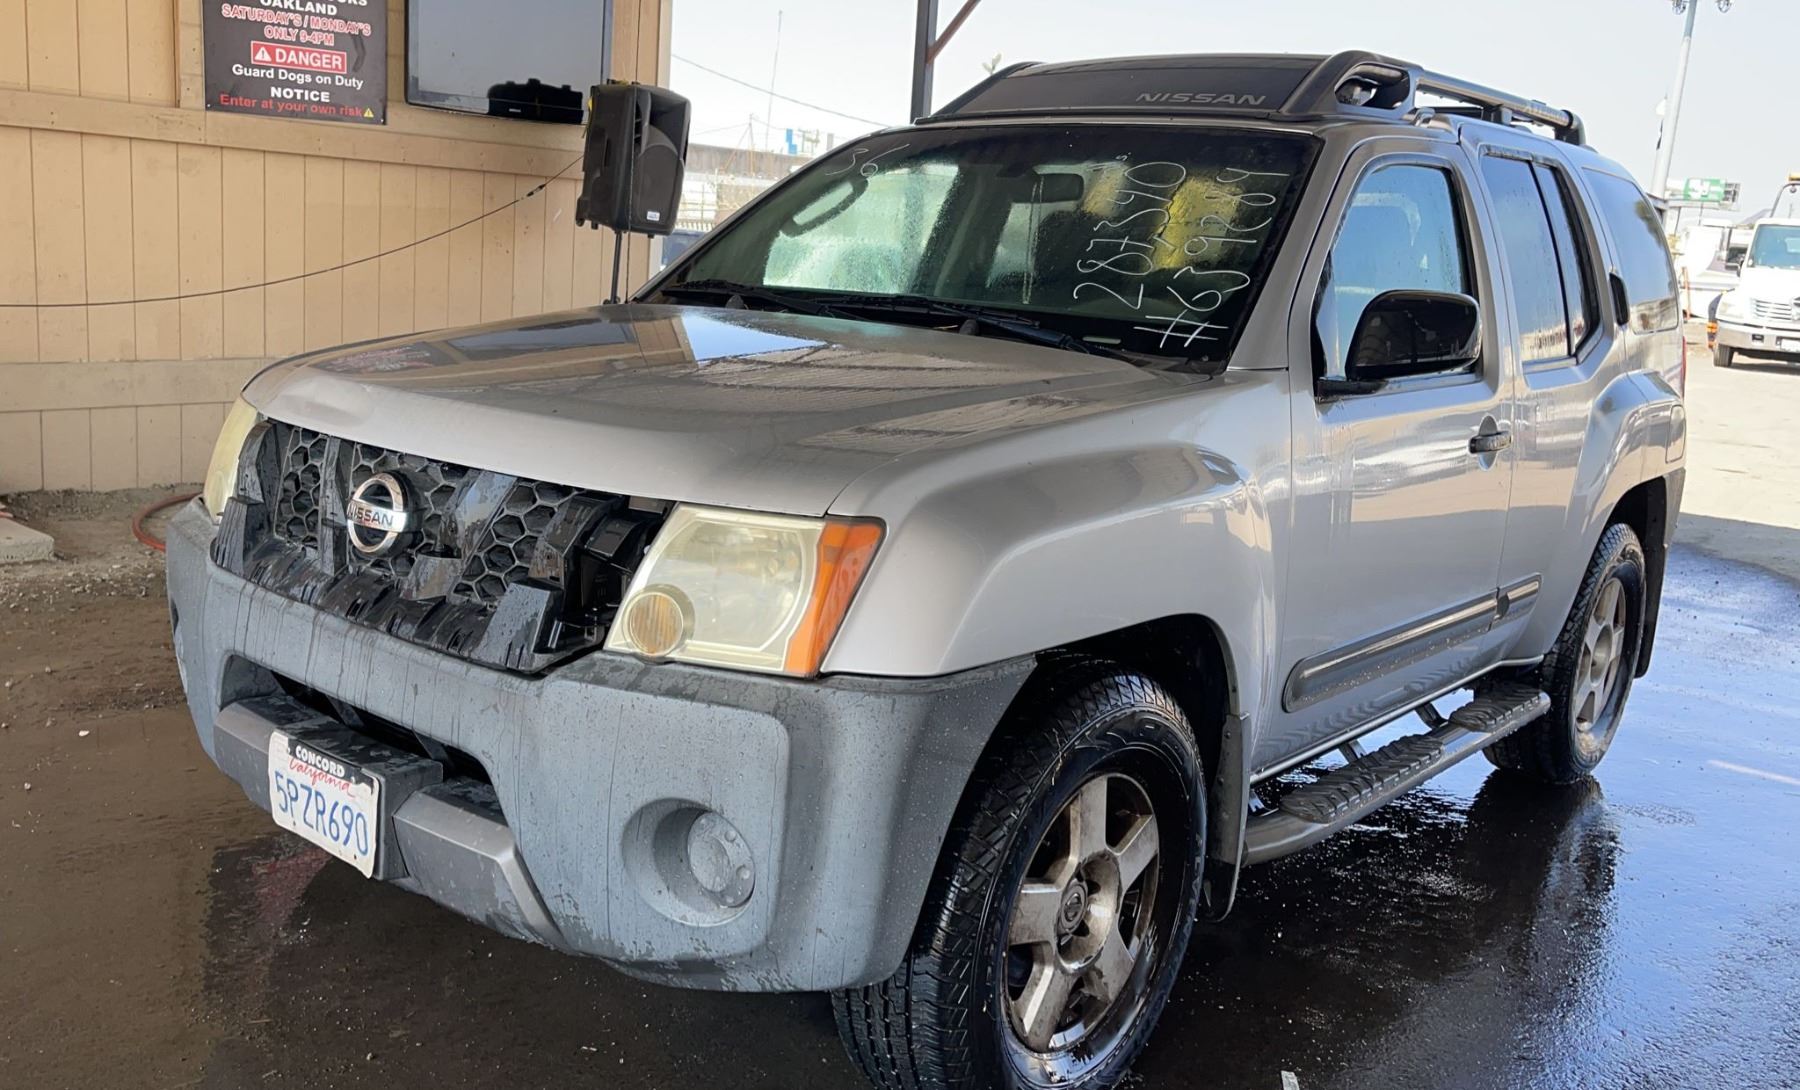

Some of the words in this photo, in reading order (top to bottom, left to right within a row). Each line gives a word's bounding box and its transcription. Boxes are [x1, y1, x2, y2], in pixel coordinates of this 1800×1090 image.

[260, 0, 338, 15] OAKLAND
[221, 3, 303, 27] SATURDAY'S
[303, 15, 309, 28] /
[309, 15, 372, 36] MONDAY'S
[264, 25, 299, 41] ONLY
[299, 29, 335, 46] 9-4PM
[275, 48, 343, 70] DANGER
[232, 63, 274, 79] Guard
[278, 68, 312, 84] Dogs
[315, 75, 332, 84] on
[335, 75, 364, 90] Duty
[220, 93, 257, 108] Enter
[261, 99, 273, 109] at
[276, 102, 308, 112] your
[310, 104, 336, 114] own
[340, 105, 362, 116] risk
[270, 86, 330, 102] NOTICE
[1135, 93, 1266, 105] NISSAN
[346, 502, 394, 526] NISSAN
[295, 745, 345, 778] CONCORD
[274, 770, 369, 856] 5PZR690
